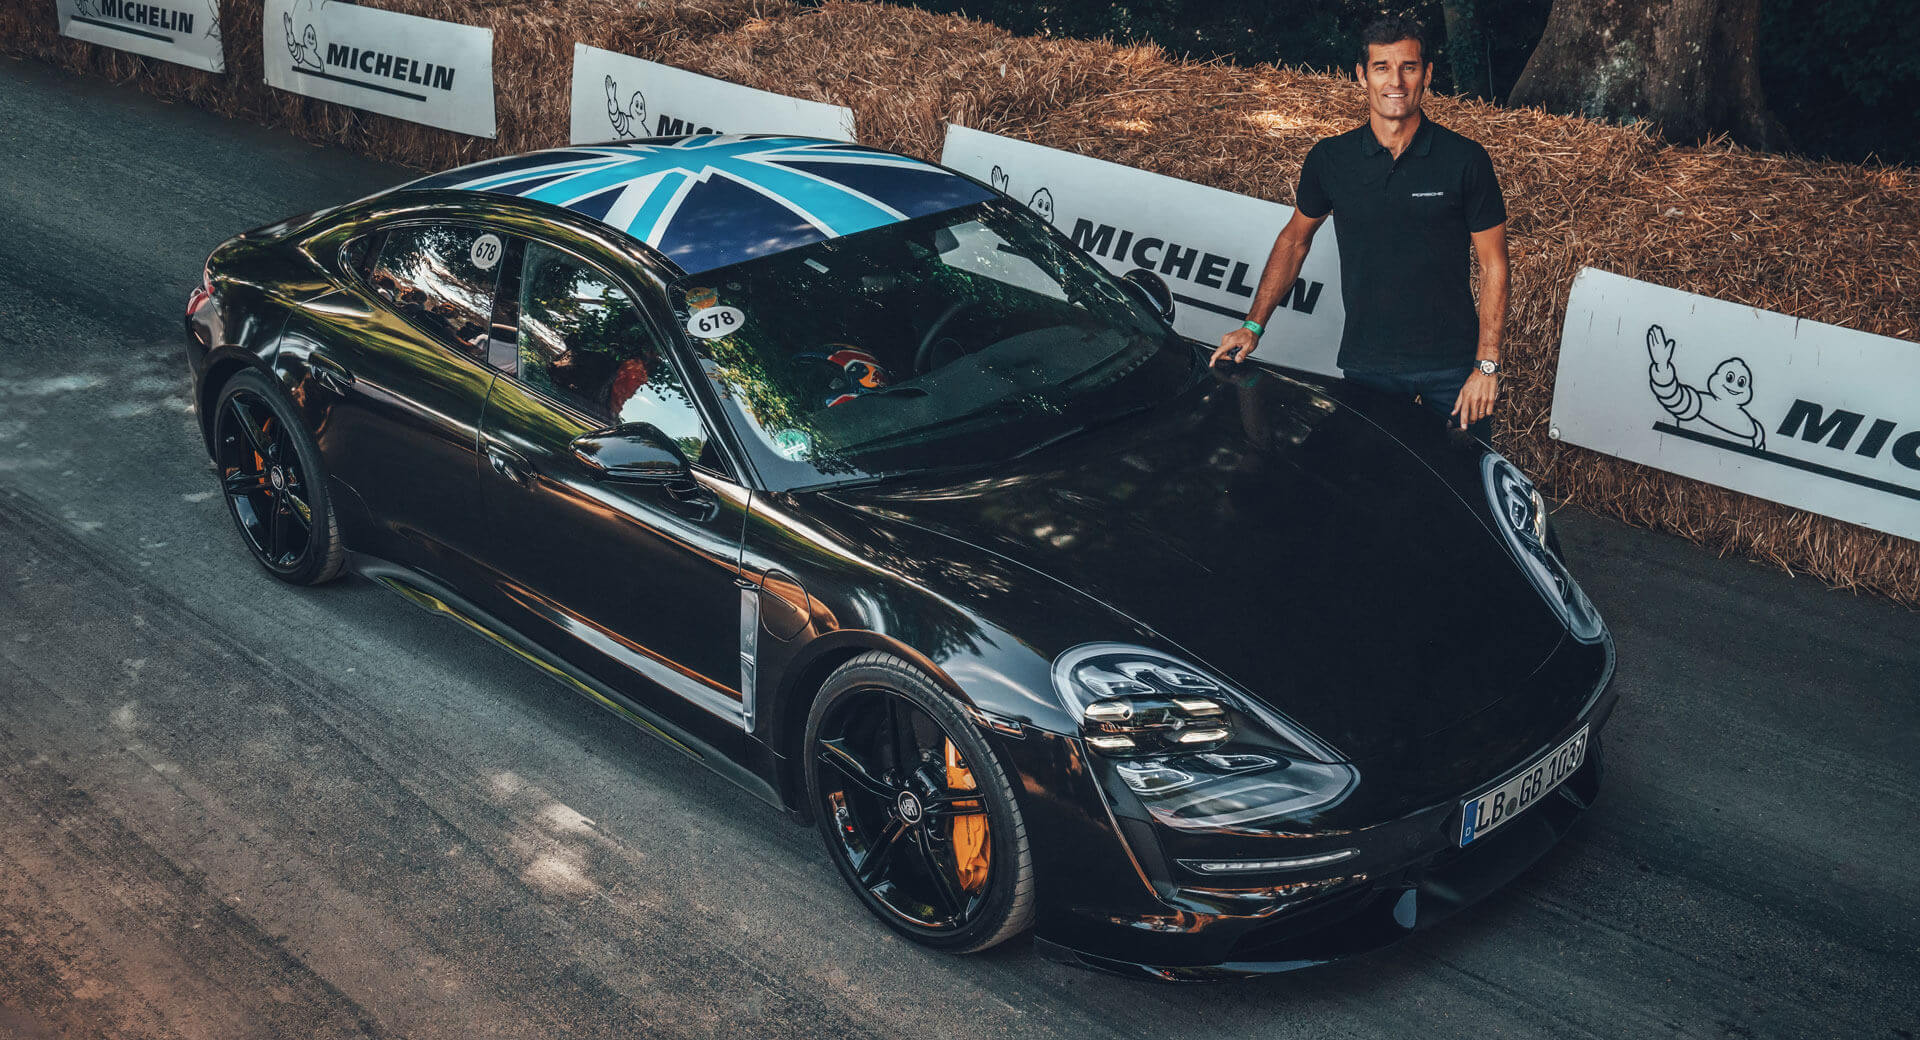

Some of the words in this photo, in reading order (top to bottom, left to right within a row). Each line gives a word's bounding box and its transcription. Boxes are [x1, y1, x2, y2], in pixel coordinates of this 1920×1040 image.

[101, 0, 194, 34] MICHELIN
[326, 43, 455, 91] MICHELIN
[476, 242, 497, 261] 678
[1070, 218, 1325, 315] MICHELN
[698, 311, 735, 332] 678
[1475, 792, 1506, 833] LB
[1519, 767, 1543, 807] GB
